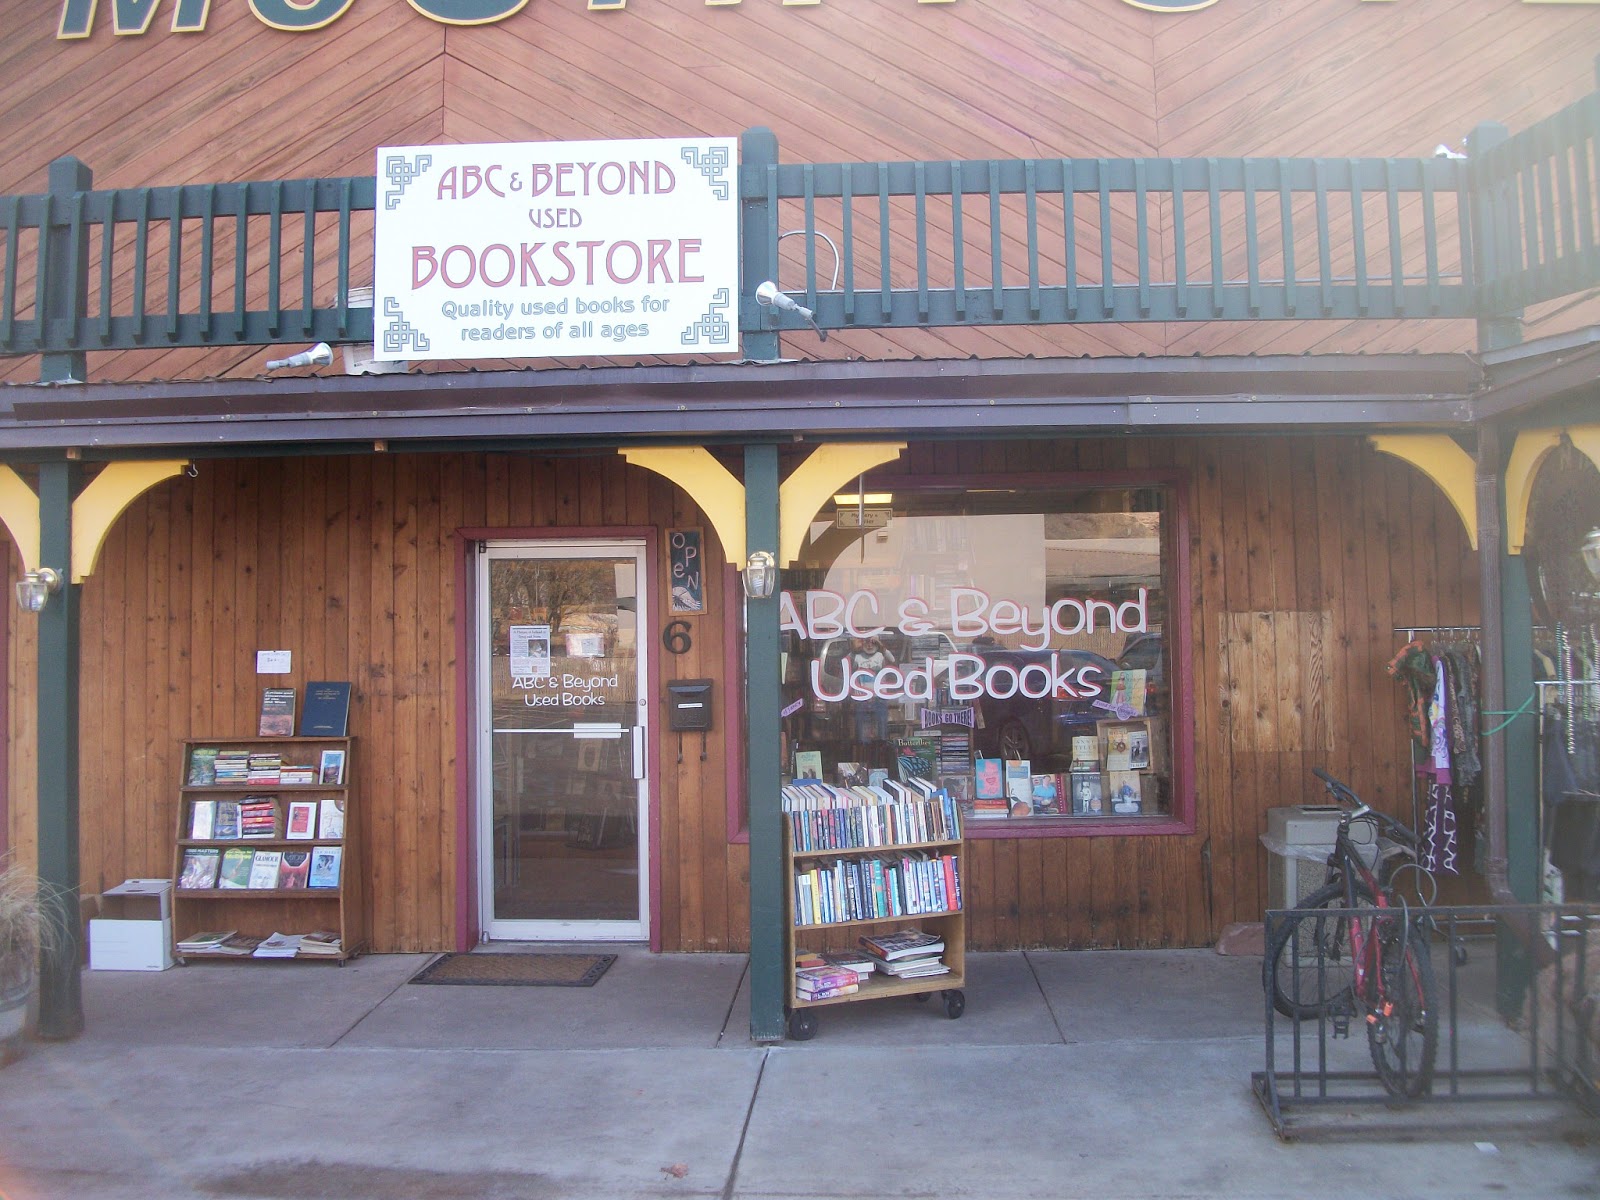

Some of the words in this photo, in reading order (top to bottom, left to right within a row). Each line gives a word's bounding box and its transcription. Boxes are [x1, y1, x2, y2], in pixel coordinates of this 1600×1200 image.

[437, 164, 505, 200] ABC
[509, 171, 523, 192] &
[532, 160, 676, 197] BEYOND
[528, 207, 583, 229] USED
[411, 238, 705, 290] BOOKSTORE
[441, 299, 514, 320] Quality
[520, 297, 568, 316] used
[575, 296, 635, 315] books
[641, 294, 670, 313] for
[461, 322, 535, 341] readers
[542, 321, 563, 339] of
[569, 320, 594, 339] all
[601, 322, 649, 343] ages
[780, 589, 887, 639] ABC
[898, 596, 936, 637] &
[950, 586, 1149, 652] Beyond
[663, 620, 692, 655] 6
[512, 676, 545, 689] ABC
[548, 676, 559, 688] &
[563, 673, 618, 692] Beyond
[811, 655, 935, 702] Used
[948, 651, 1103, 700] Books
[524, 693, 559, 706] Used
[562, 692, 605, 706] Books
[944, 713, 953, 723] GO
